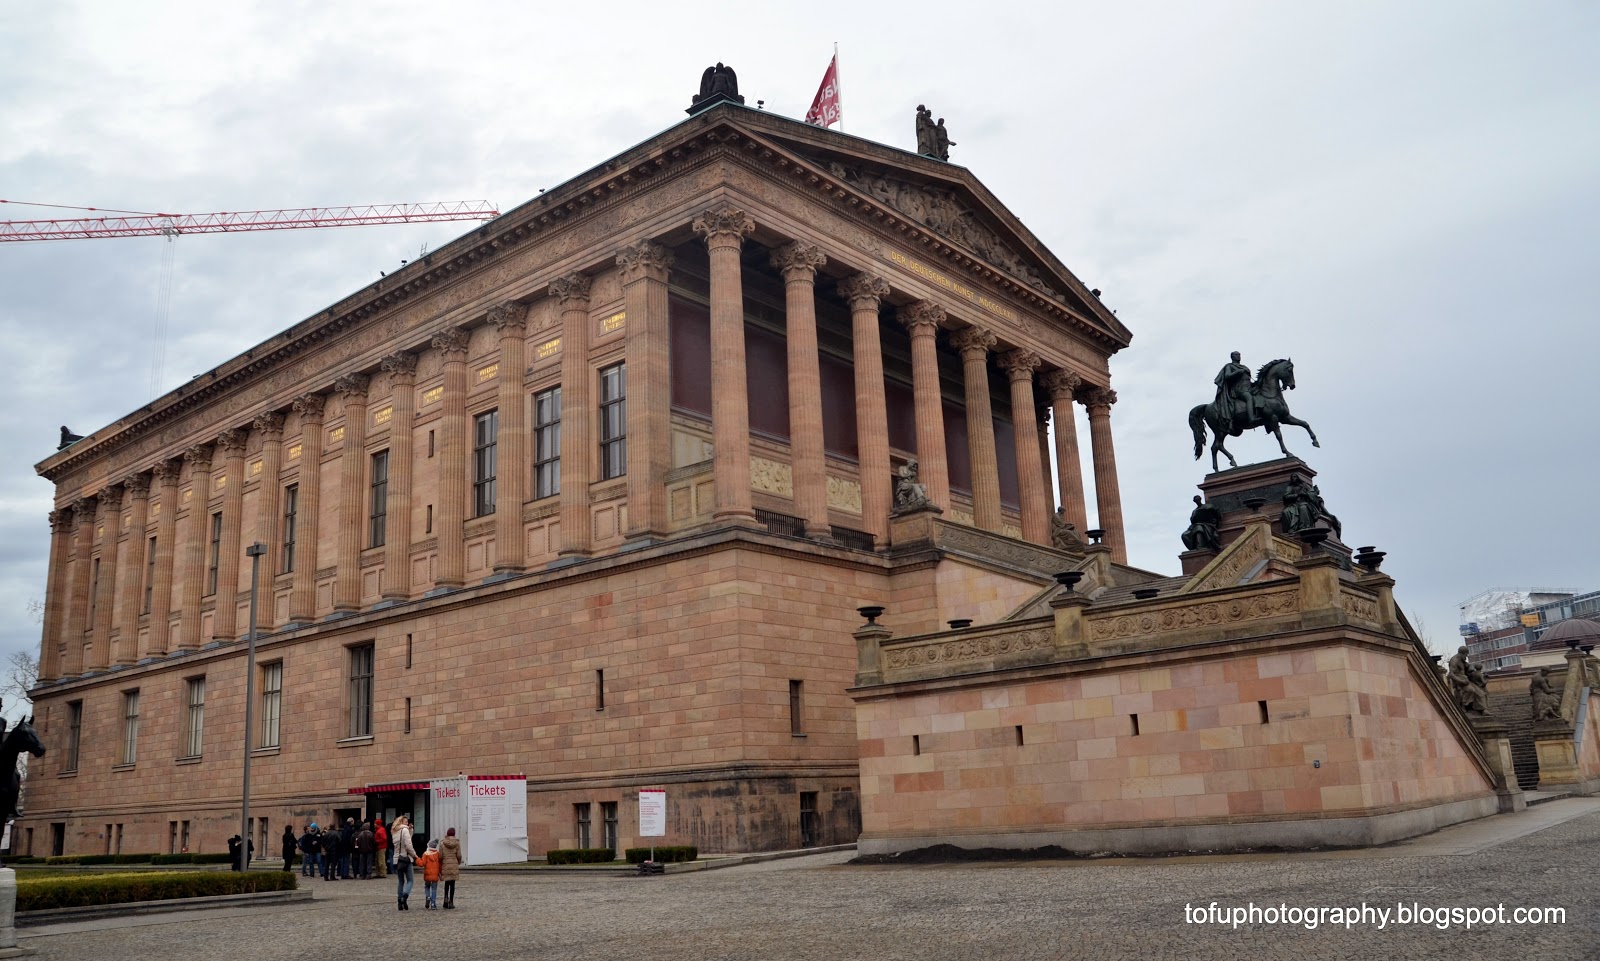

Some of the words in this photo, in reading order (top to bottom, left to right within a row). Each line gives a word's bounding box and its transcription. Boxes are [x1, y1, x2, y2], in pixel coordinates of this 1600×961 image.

[891, 251, 906, 266] DER
[910, 262, 951, 288] DEUTSCHEN
[953, 282, 975, 300] KUNST
[979, 296, 1014, 319] MDCCCLXXI
[435, 787, 461, 799] Tickets
[469, 784, 506, 796] Tickets
